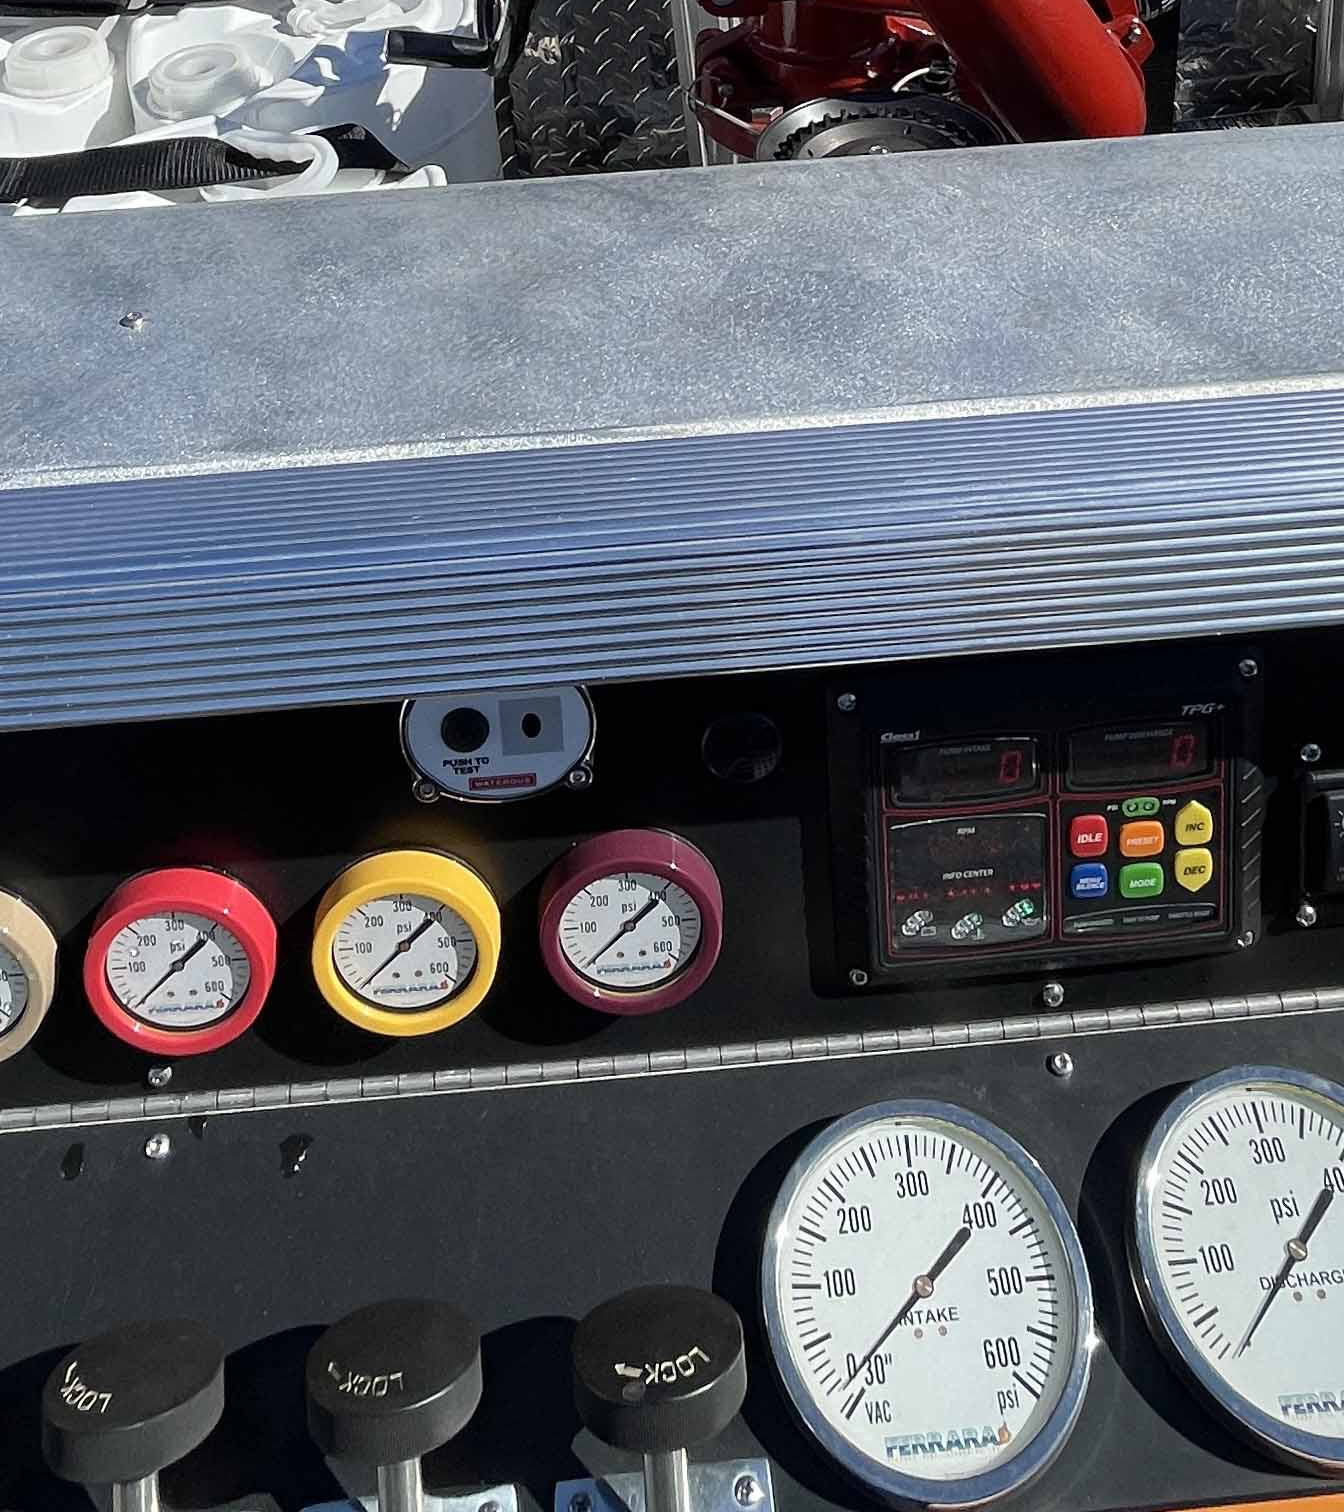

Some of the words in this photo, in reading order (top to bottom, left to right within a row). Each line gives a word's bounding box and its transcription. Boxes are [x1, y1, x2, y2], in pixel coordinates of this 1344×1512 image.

[443, 758, 473, 768] PUSH
[453, 765, 480, 775] TEST
[1185, 822, 1205, 832] INC
[1077, 832, 1103, 843] IDLE
[963, 869, 994, 879] CENTER
[1183, 865, 1206, 876] DEC
[1130, 878, 1156, 888] MODE
[590, 895, 609, 907] 200
[621, 902, 637, 914] psi
[364, 915, 384, 928] 200
[579, 922, 597, 933] 100
[662, 915, 680, 928] 500
[396, 922, 412, 935] psi
[137, 934, 157, 947] 200
[437, 936, 456, 948] 500
[653, 940, 673, 953] 600
[169, 941, 185, 954] psi
[355, 942, 372, 954] 100
[128, 961, 146, 973] 100
[211, 955, 231, 968] 500
[430, 962, 449, 974] 600
[205, 980, 225, 993] 600
[1248, 1137, 1286, 1165] 300
[894, 1170, 930, 1199] 300
[1200, 1178, 1237, 1206] 200
[1269, 1190, 1301, 1225] psi
[837, 1205, 872, 1235] 200
[962, 1201, 997, 1230] 400
[1198, 1243, 1235, 1274] 100
[823, 1268, 856, 1298] 100
[986, 1266, 1024, 1297] 500
[983, 1336, 1021, 1369] 600
[645, 1346, 710, 1384] LOCK
[846, 1352, 858, 1380] 0
[998, 1384, 1020, 1415] psi
[865, 1400, 892, 1424] VAC
[884, 1426, 1002, 1459] FERRARA
